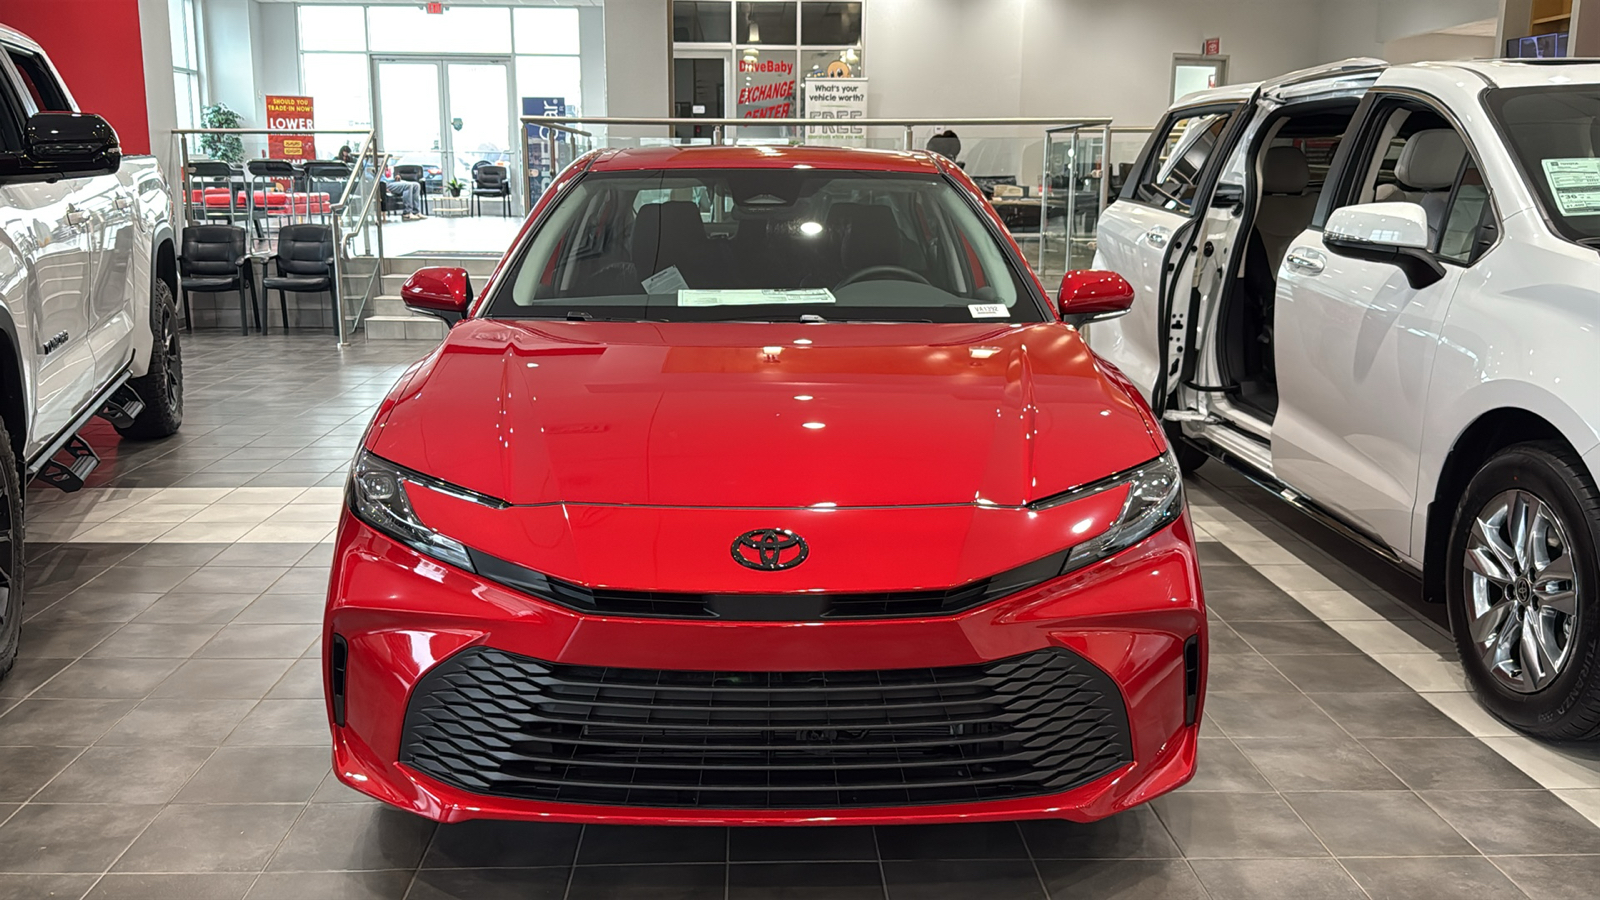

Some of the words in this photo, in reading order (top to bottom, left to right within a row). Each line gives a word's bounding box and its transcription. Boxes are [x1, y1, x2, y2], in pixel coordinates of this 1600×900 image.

[739, 60, 793, 75] DriveBaby
[738, 80, 795, 105] EXCHANGE
[814, 84, 839, 92] What's
[842, 85, 859, 94] your
[809, 93, 836, 102] vehicle
[837, 93, 864, 102] worth?
[269, 117, 314, 129] LOWER
[809, 110, 863, 134] FREE
